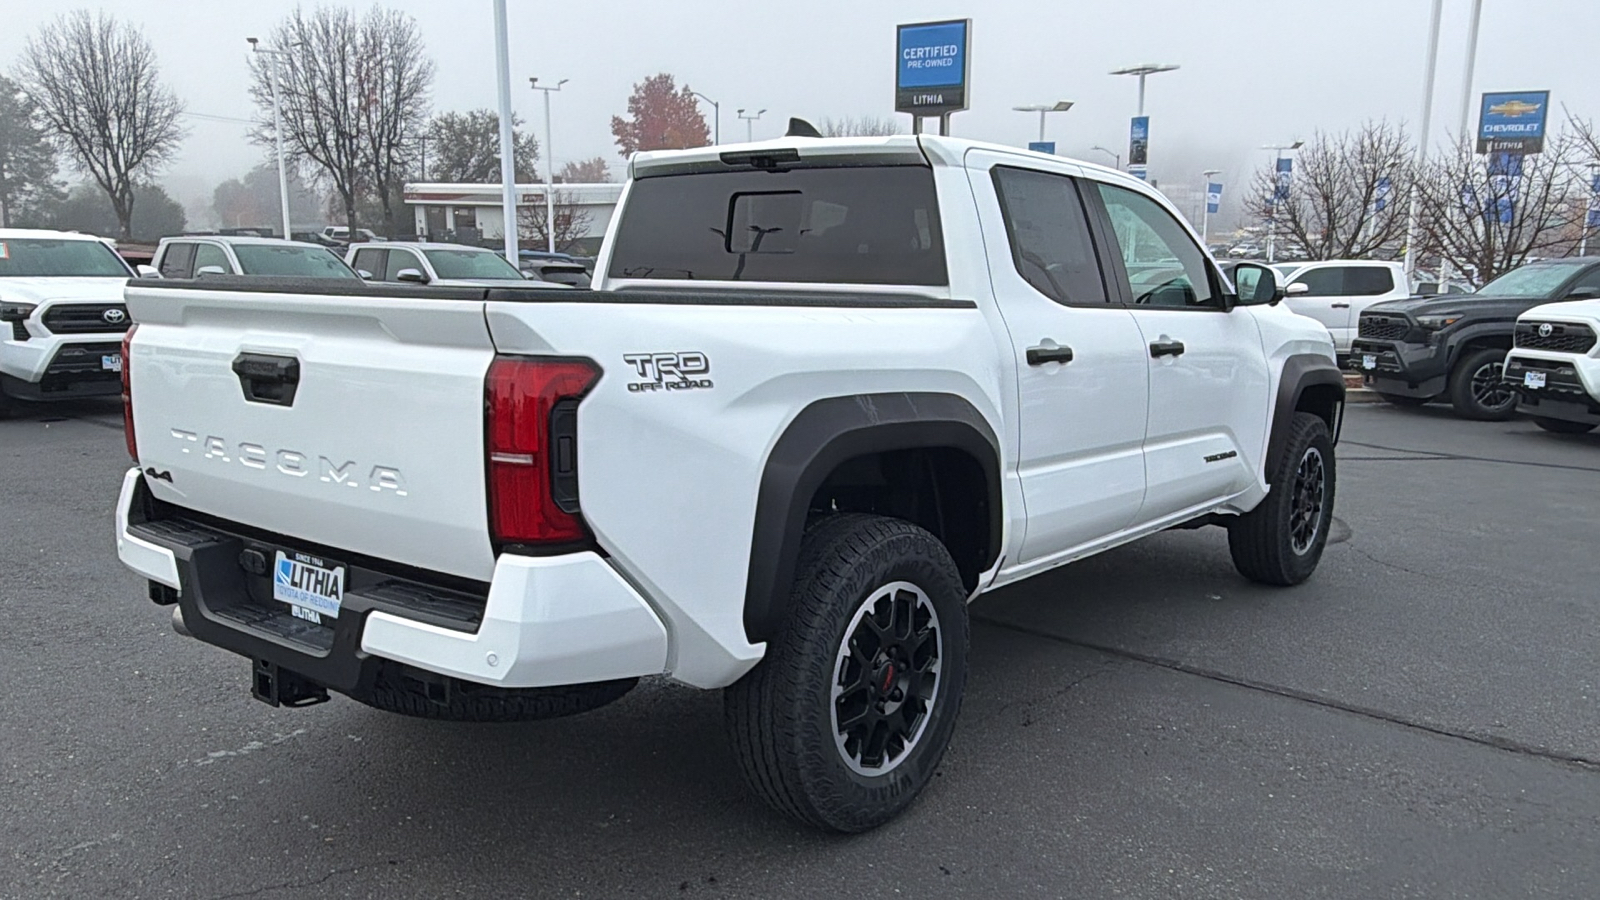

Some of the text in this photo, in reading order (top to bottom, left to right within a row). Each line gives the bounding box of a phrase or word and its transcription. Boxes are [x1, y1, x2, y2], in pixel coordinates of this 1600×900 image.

[903, 45, 957, 60] CERTIFIED
[907, 58, 953, 69] PRE-OWNED
[913, 94, 943, 105] LITHIA
[1483, 123, 1539, 132] CHEVROLET
[1494, 142, 1523, 150] LITHIA
[623, 351, 709, 382] TRD
[627, 379, 714, 392] OFF ROAD
[171, 428, 408, 496] TACOMA
[295, 553, 310, 564] SINCE
[291, 563, 340, 601] LITHIA
[300, 591, 308, 602] OF
[299, 607, 321, 625] LITHIA
